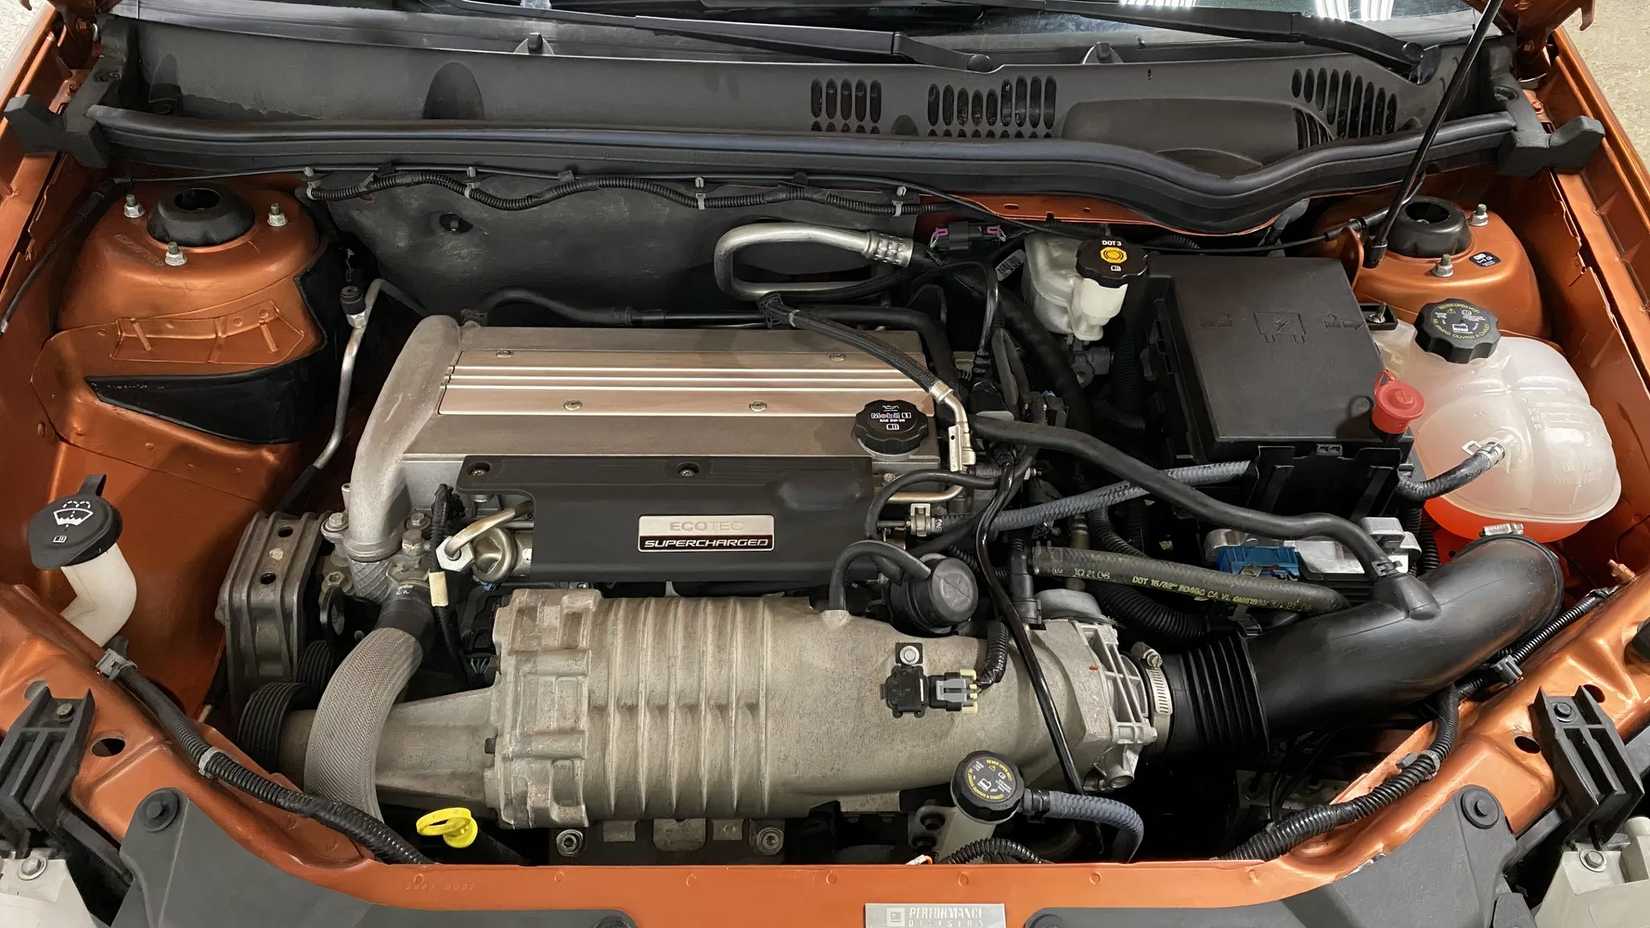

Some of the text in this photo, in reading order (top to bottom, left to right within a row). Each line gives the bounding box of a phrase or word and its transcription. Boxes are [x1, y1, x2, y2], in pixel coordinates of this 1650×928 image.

[670, 521, 745, 532] ECOTEC
[644, 538, 769, 549] SUPERCHARGED
[1132, 575, 1149, 585] DOT
